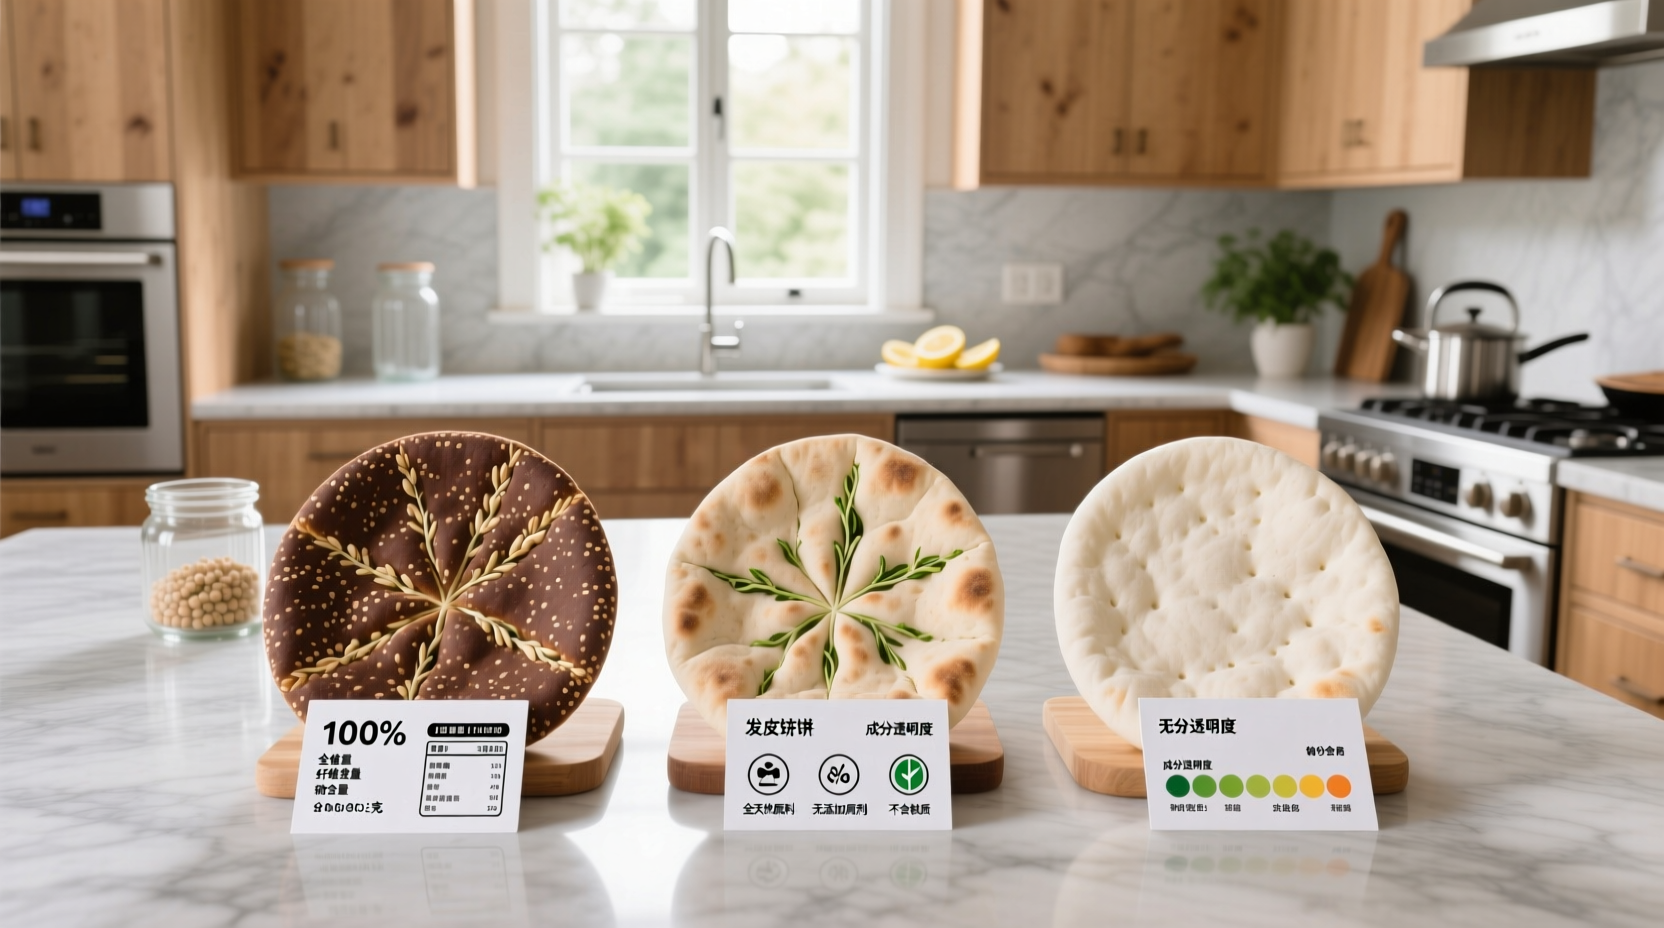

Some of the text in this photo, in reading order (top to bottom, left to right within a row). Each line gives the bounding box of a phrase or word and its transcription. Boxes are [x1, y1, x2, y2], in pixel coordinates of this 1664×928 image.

[323, 720, 406, 746] 100%
[1158, 717, 1237, 735] 无分透明度
